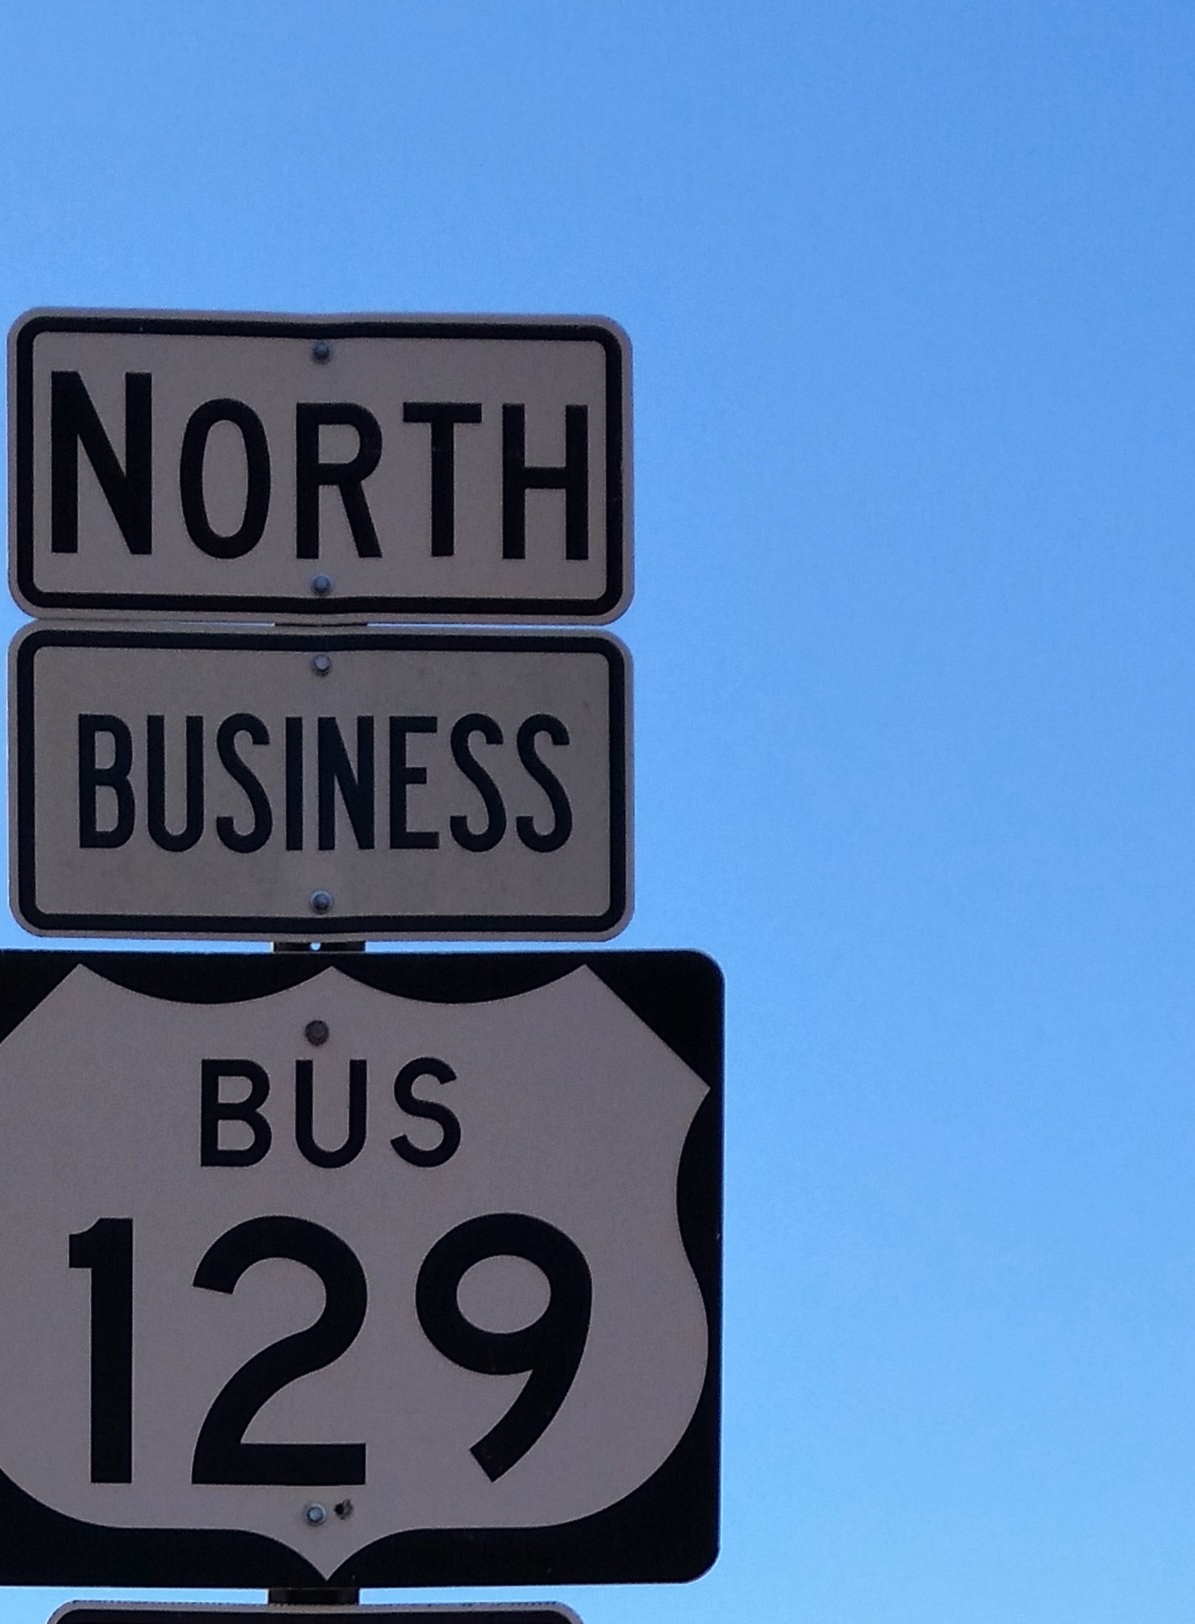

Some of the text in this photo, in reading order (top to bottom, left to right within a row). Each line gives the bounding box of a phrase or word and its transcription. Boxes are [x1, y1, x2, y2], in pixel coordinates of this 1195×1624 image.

[51, 371, 589, 562] NORTH
[78, 712, 573, 854] BUSINESS
[200, 1056, 462, 1169] BUS
[68, 1212, 593, 1486] 129
